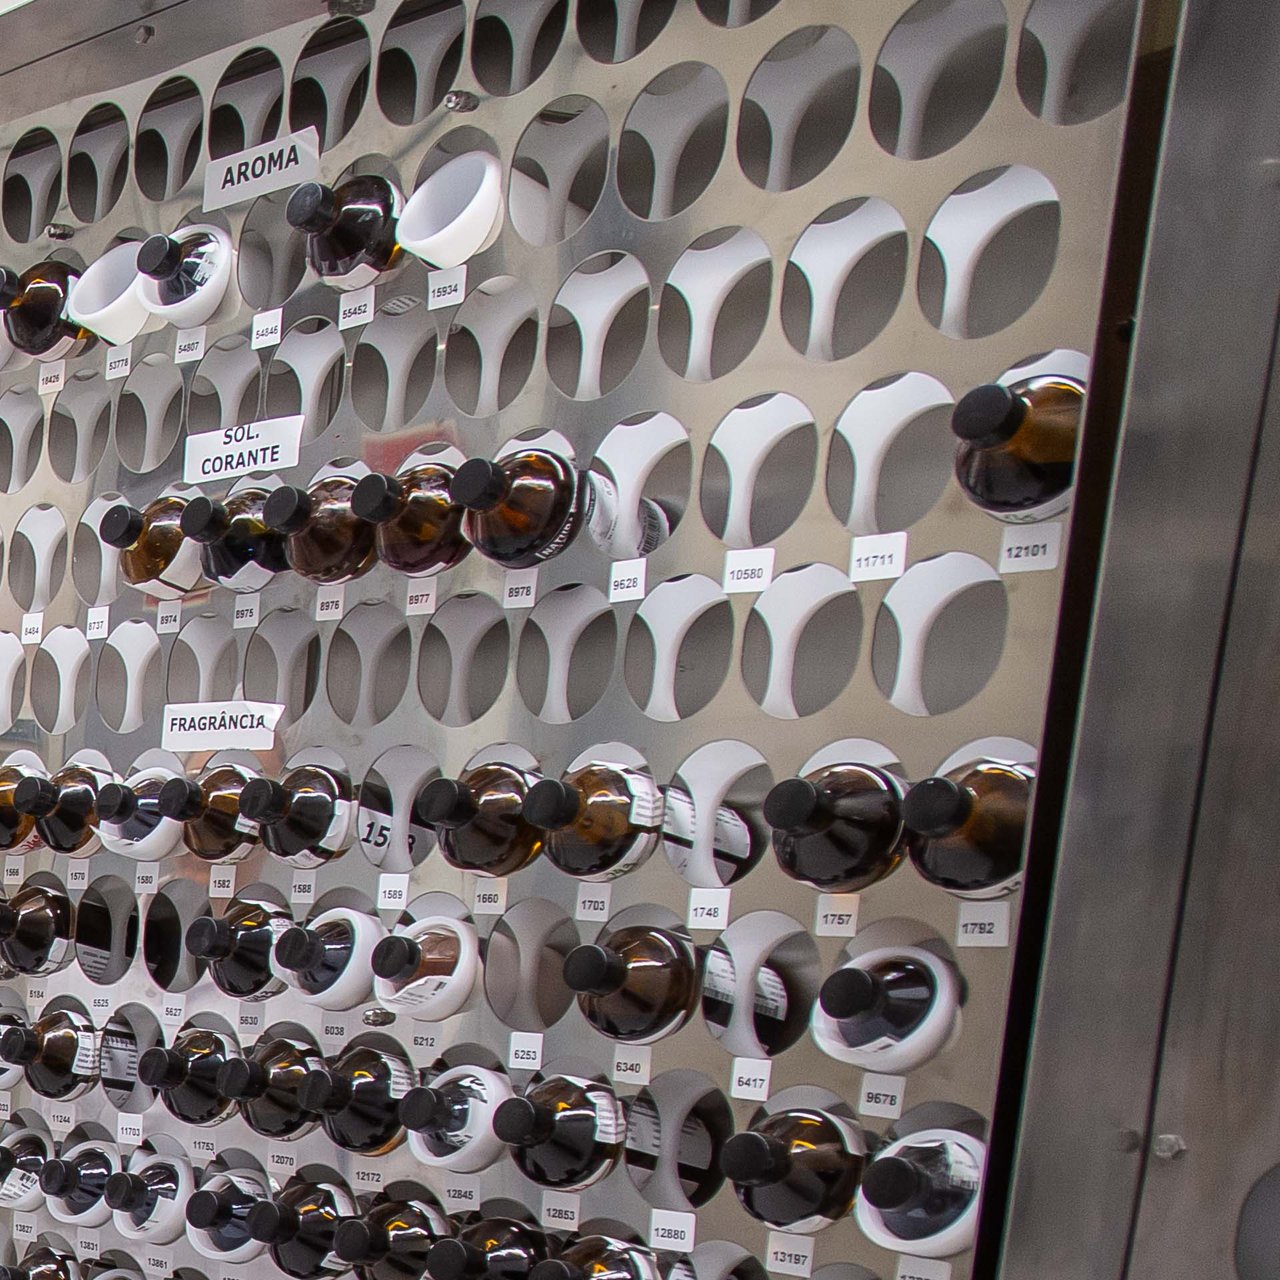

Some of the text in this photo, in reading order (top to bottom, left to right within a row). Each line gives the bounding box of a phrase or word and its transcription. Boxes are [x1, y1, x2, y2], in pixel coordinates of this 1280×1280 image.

[221, 144, 300, 190] AROMA
[431, 283, 459, 299] 15934
[342, 303, 368, 320] 55452
[178, 341, 200, 354] 54807
[108, 357, 129, 371] 53778
[222, 424, 259, 445] SOL.
[201, 445, 280, 475] CORANTE
[1006, 543, 1048, 559] 12101
[855, 553, 894, 569] 11711
[729, 567, 764, 581] 10580
[613, 576, 638, 591] 9628
[507, 585, 532, 598] 8978
[319, 599, 340, 612] 8976
[408, 593, 431, 606] 8977
[160, 614, 178, 625] 8974
[235, 608, 254, 620] 8975
[88, 620, 105, 631] 8737
[169, 709, 266, 732] FRAGRÂNCIA
[213, 879, 231, 889] 1582
[292, 883, 312, 894] 1588
[382, 889, 403, 900] 1589
[476, 893, 499, 904] 1660
[581, 899, 605, 912] 1703
[692, 906, 719, 918] 1748
[822, 913, 853, 925] 1757
[961, 922, 995, 935] 1792
[239, 1015, 259, 1026] 5630
[324, 1025, 345, 1036] 6038
[413, 1036, 435, 1048] 6212
[514, 1049, 537, 1061] 6253
[615, 1061, 641, 1074] 6340
[737, 1076, 766, 1089] 6417
[866, 1091, 898, 1106] 9678
[51, 1114, 71, 1124] 11244
[193, 1140, 215, 1152] 11753
[270, 1154, 295, 1167] 12070
[355, 1170, 382, 1183] 12172
[446, 1188, 474, 1201] 12845
[546, 1207, 575, 1221] 12853
[654, 1227, 686, 1241] 12880
[772, 1251, 809, 1266] 13197
